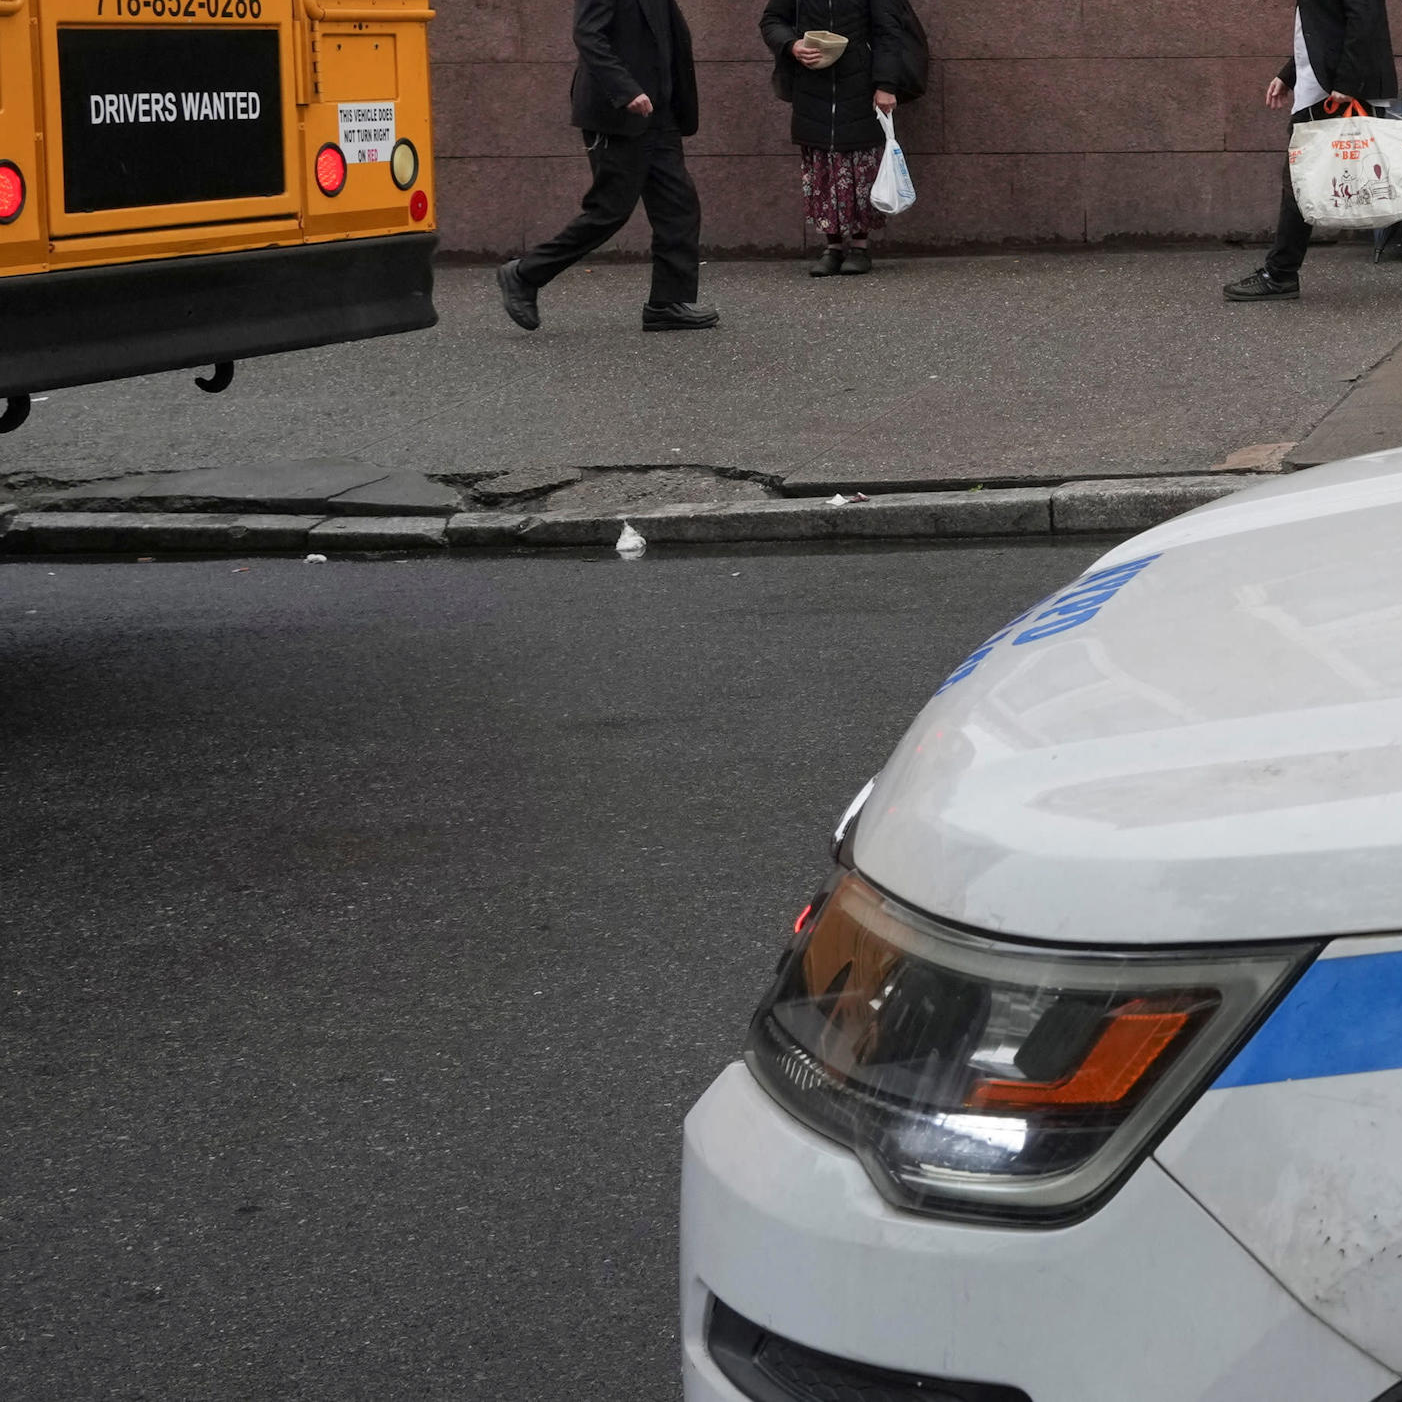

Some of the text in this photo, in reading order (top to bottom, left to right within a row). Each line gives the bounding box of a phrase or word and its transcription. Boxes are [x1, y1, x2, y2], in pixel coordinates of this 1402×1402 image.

[90, 91, 260, 126] DRIVERS WANTED
[340, 108, 392, 123] THIS VEHICLE DOES
[344, 128, 389, 143] NOT TURN RIGHT
[358, 148, 379, 163] ON RED
